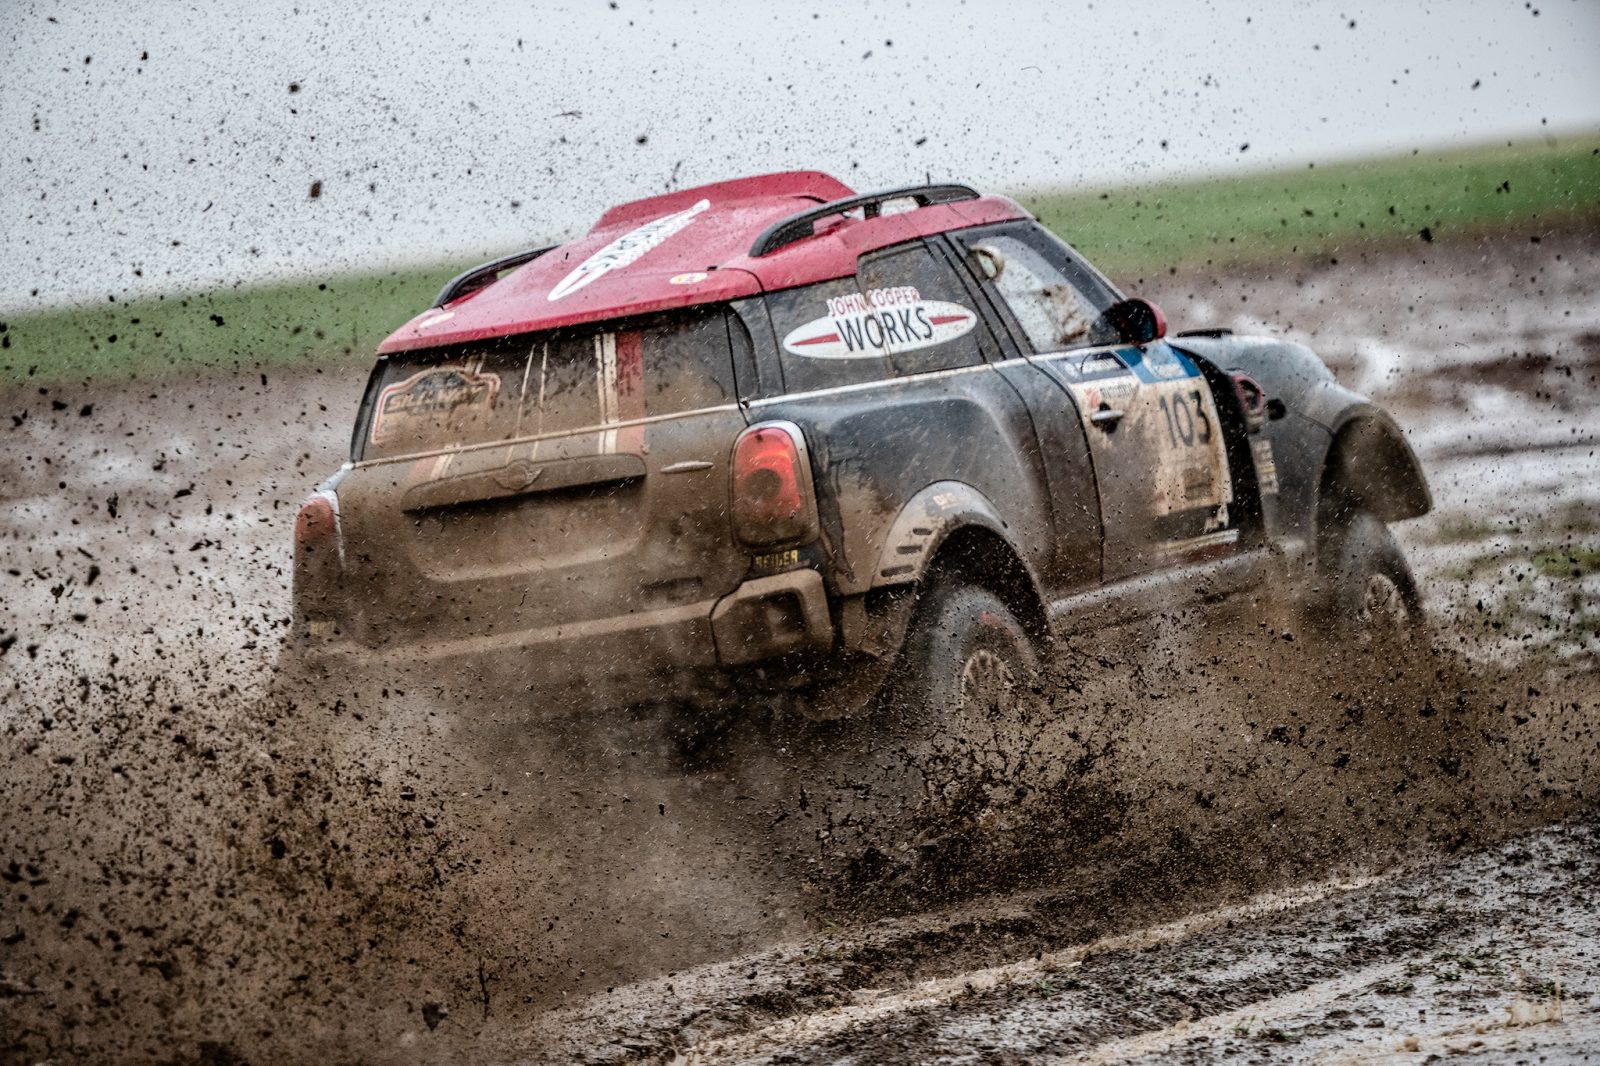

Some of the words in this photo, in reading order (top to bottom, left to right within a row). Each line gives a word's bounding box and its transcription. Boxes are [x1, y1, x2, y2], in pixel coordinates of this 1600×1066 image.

[830, 297, 868, 317] JOHN
[869, 288, 921, 308] COOPER
[835, 307, 933, 351] WORKS
[1159, 389, 1211, 448] 103
